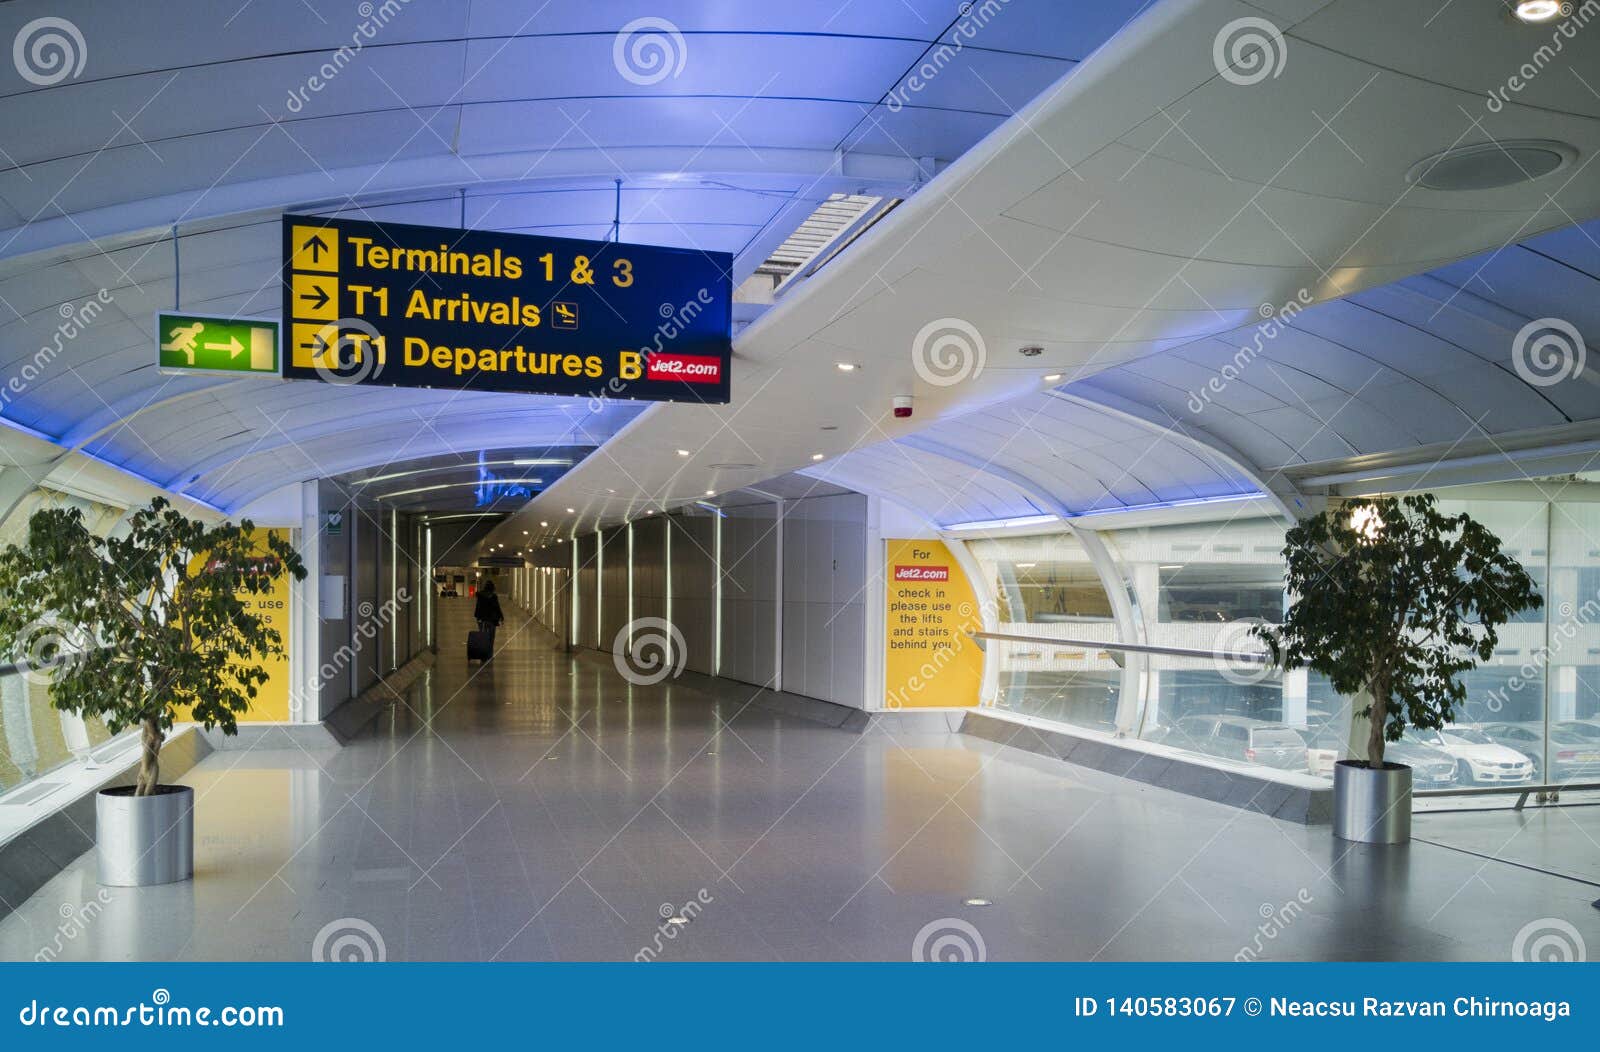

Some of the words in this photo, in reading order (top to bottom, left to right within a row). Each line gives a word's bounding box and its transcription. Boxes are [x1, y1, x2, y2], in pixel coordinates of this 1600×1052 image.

[347, 236, 523, 281] Terminals
[538, 252, 554, 282] 1
[571, 255, 595, 285] &
[612, 258, 635, 288] 3
[347, 284, 389, 317] T1
[405, 289, 541, 328] Arrivals
[346, 333, 387, 366] T1
[404, 336, 603, 379] Departures
[619, 351, 642, 380] B
[912, 549, 931, 560] For
[898, 588, 931, 598] check
[936, 588, 945, 598] in
[258, 600, 284, 609] use
[891, 601, 928, 612] please
[932, 603, 952, 612] use
[900, 614, 917, 624] the
[922, 614, 943, 624] lifts
[893, 626, 913, 637] and
[918, 626, 949, 637] stairs
[890, 639, 927, 649] behind
[932, 640, 952, 651] you
